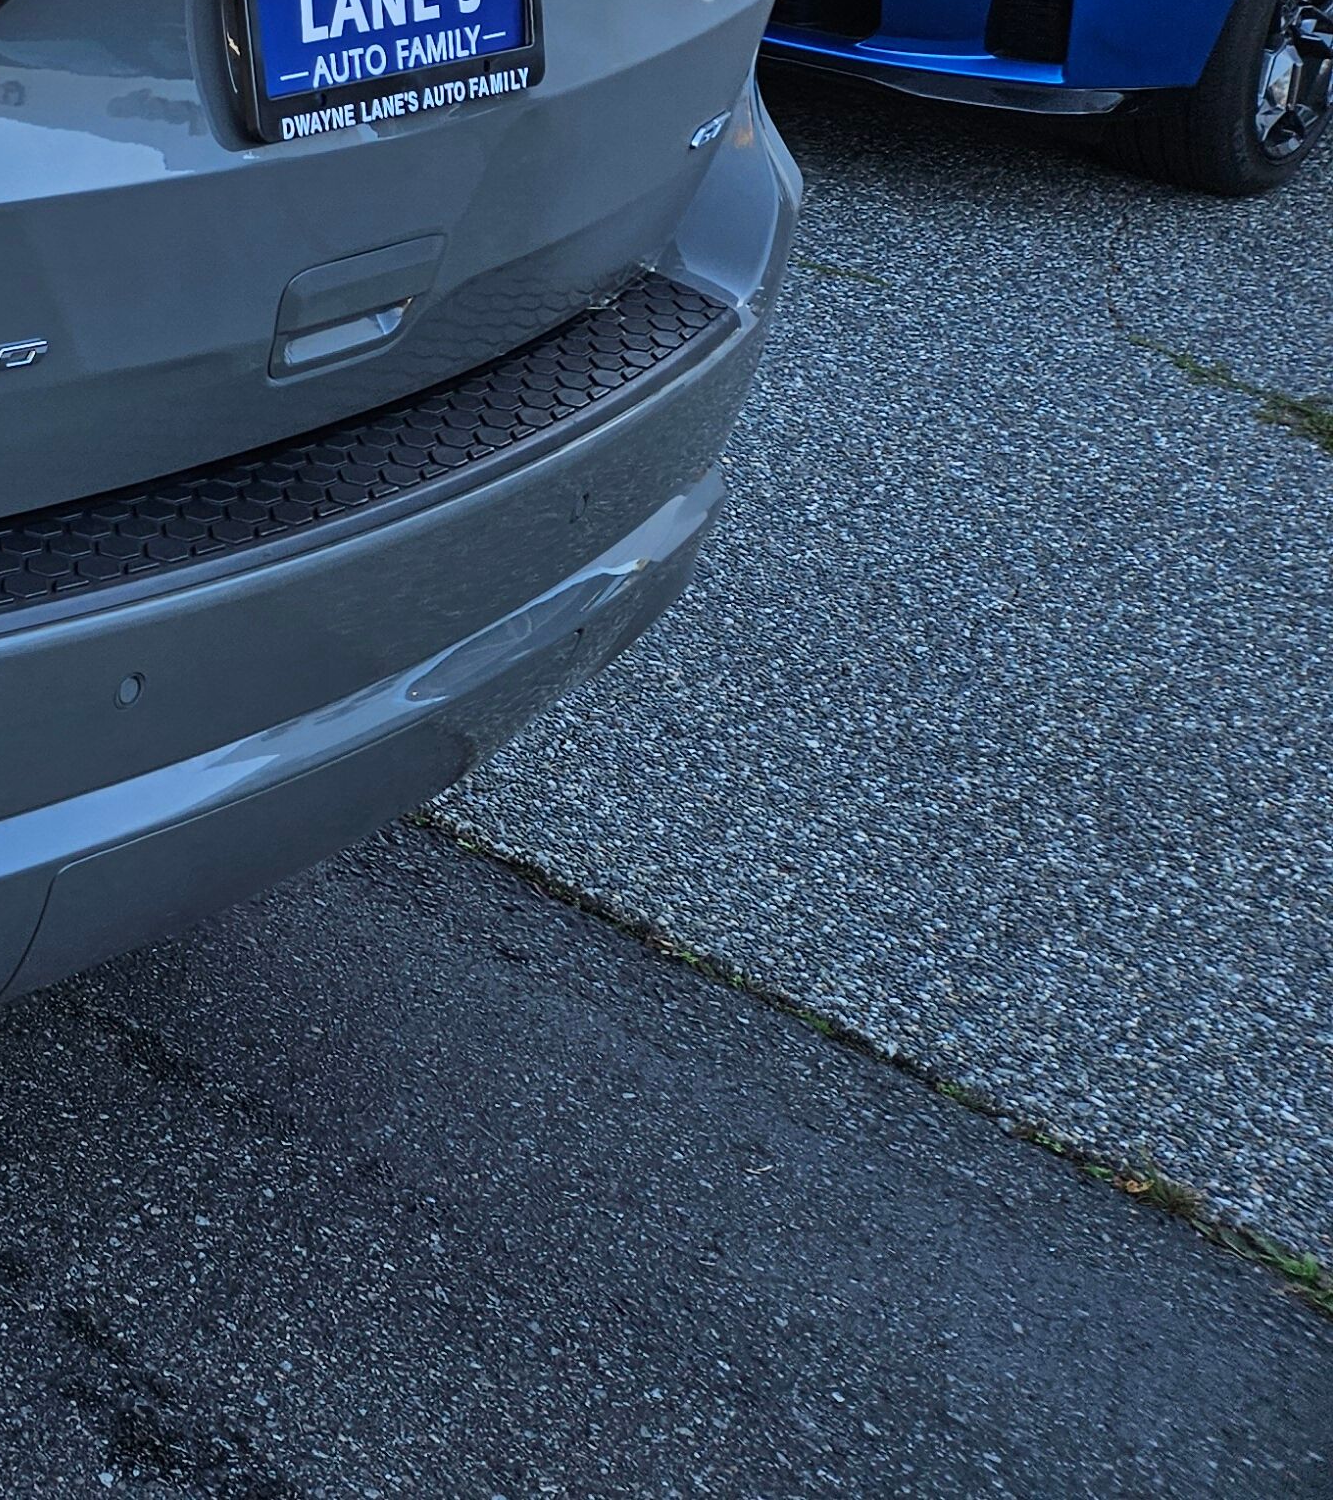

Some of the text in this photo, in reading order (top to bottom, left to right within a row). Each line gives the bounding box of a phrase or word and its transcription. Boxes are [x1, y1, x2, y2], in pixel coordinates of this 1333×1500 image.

[312, 24, 481, 89] AUTO FAMILY
[281, 67, 530, 141] DWAYNE LANE'S AUTO FAMILY
